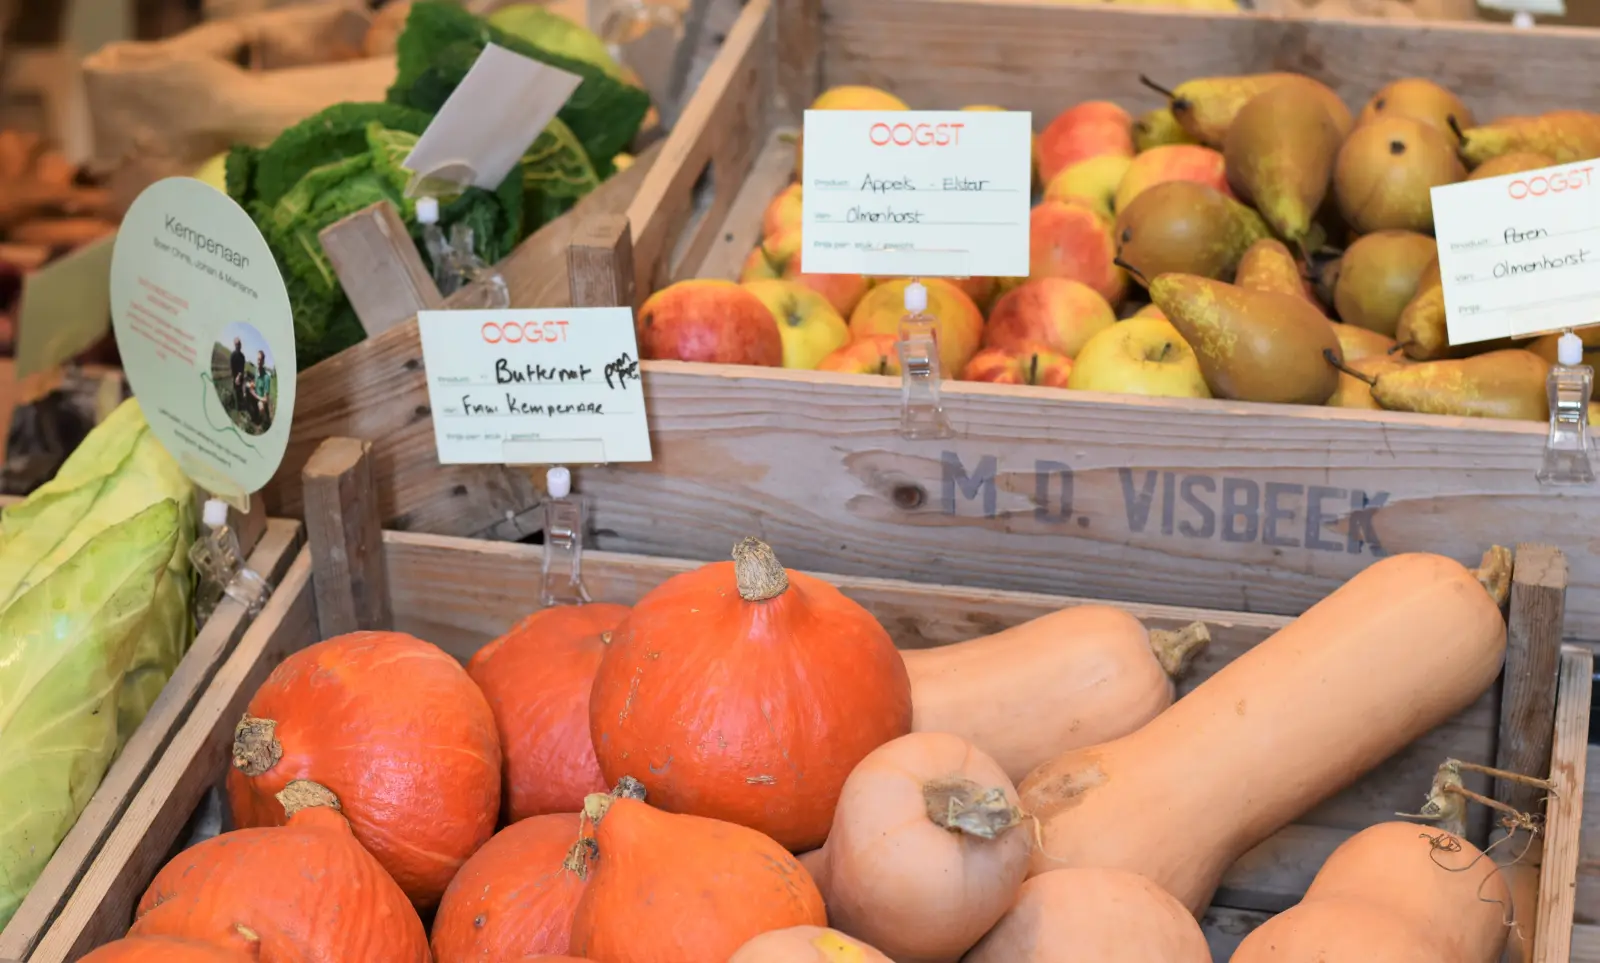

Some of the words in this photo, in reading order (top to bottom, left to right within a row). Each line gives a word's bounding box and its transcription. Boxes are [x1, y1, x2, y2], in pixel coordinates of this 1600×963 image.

[869, 122, 965, 146] OOGST
[860, 173, 916, 194] Appels
[942, 175, 990, 192] Elstar
[1508, 167, 1594, 199] OOGST
[846, 204, 925, 224] Olmenhorst
[164, 213, 250, 269] Kempenaar
[1492, 248, 1591, 279] Olmenhorst
[481, 321, 569, 343] OOGST
[495, 358, 592, 384] Butternut
[1118, 467, 1391, 558] VISBEEK
